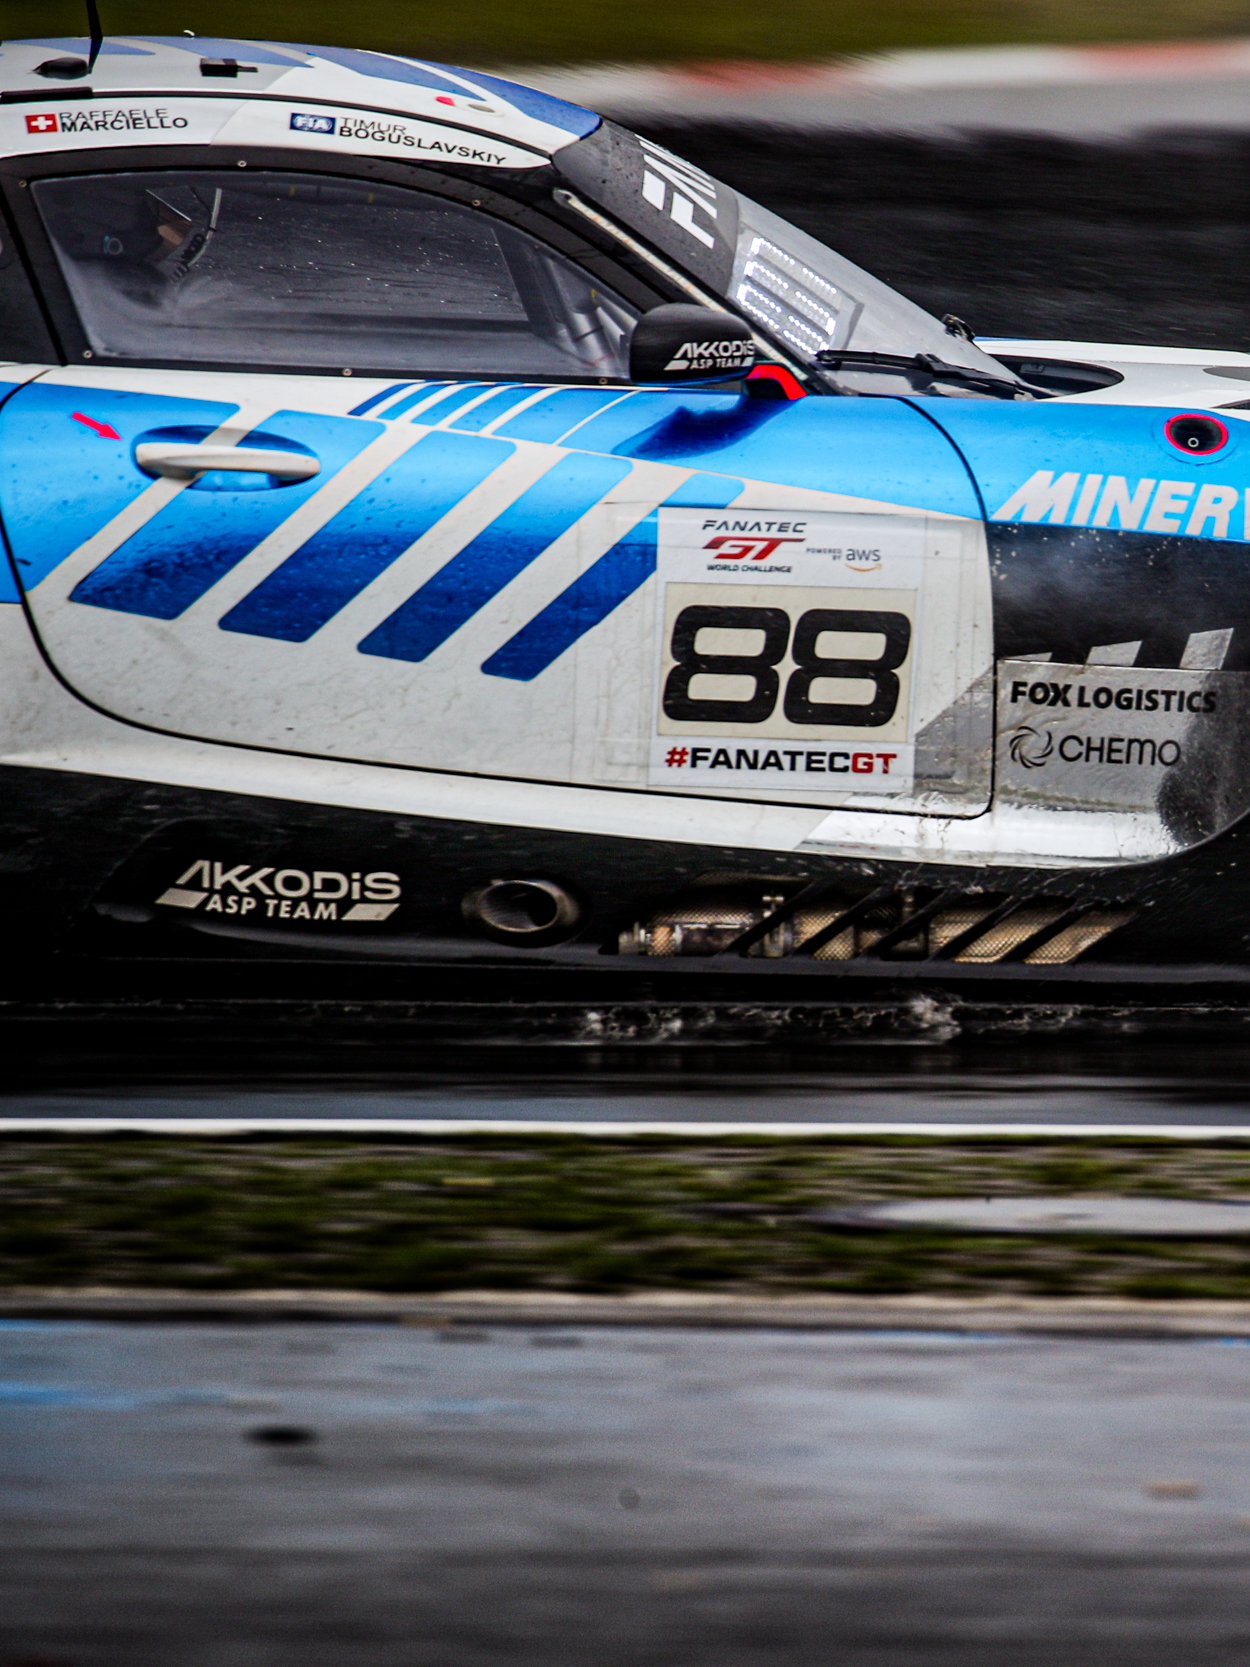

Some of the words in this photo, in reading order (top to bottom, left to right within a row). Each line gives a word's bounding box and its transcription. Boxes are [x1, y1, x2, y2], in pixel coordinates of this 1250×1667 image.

[59, 108, 169, 121] RAFFAELE
[61, 117, 189, 132] MARCIELLO
[296, 116, 329, 131] FIA
[341, 117, 407, 134] TIMUR
[339, 127, 507, 165] BOGUSLAVSKIY
[690, 358, 714, 370] ASP
[716, 357, 742, 368] TEAM
[702, 519, 807, 533] FANATEC
[702, 536, 806, 560] GT
[846, 548, 881, 562] aws
[706, 564, 738, 572] WORLD
[741, 564, 793, 573] CHALLENGE
[662, 604, 912, 728] 88
[1010, 681, 1073, 708] FOX
[1077, 685, 1217, 714] LOGISTICS
[665, 746, 898, 775] #FANATECGT
[205, 893, 257, 915] ASP
[265, 898, 338, 921] TEAM
